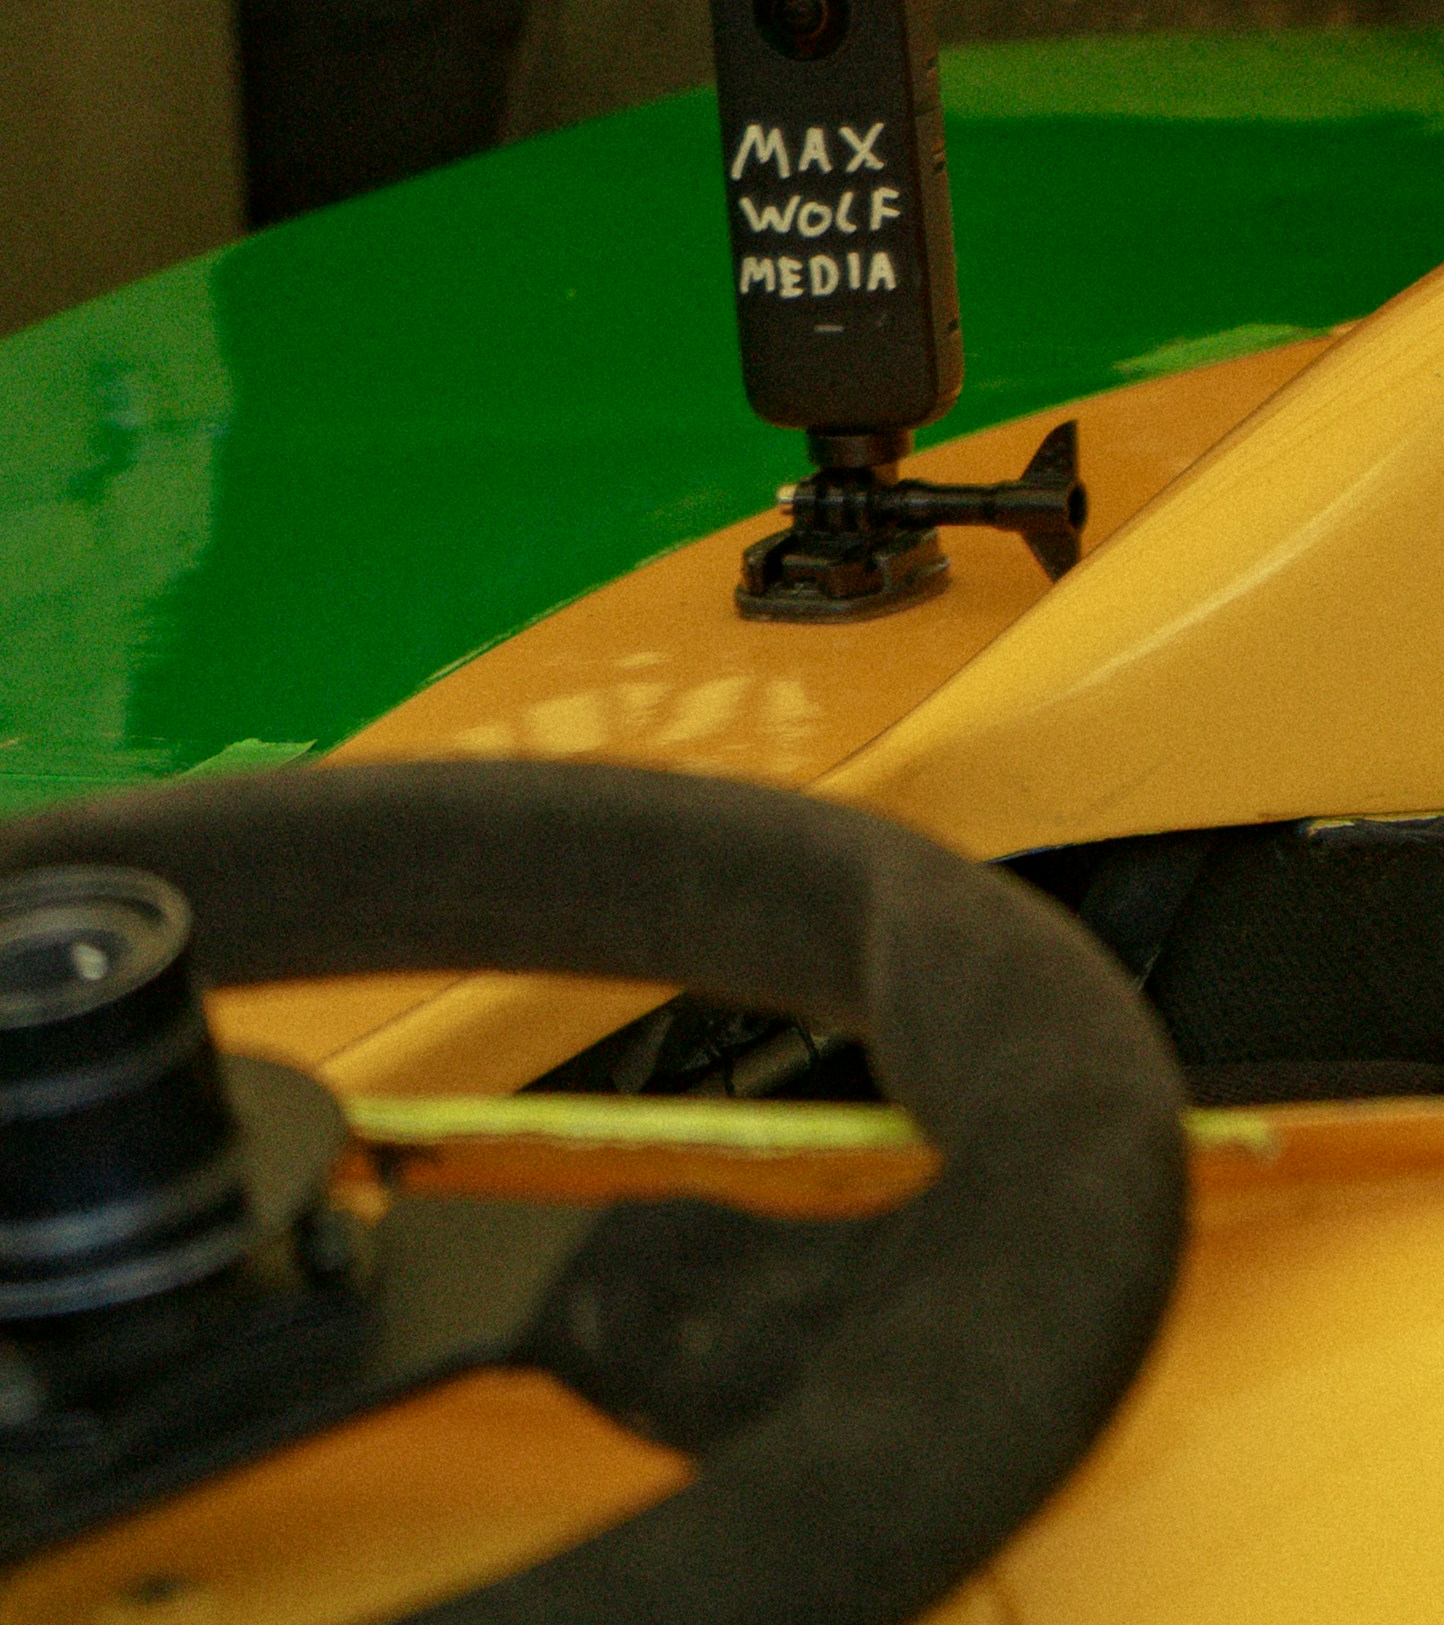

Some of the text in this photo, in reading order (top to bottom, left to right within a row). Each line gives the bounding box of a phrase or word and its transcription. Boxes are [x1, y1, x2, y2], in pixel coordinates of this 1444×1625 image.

[731, 123, 885, 180] MAX
[738, 185, 900, 238] WOLF
[739, 250, 897, 298] MEDIA
